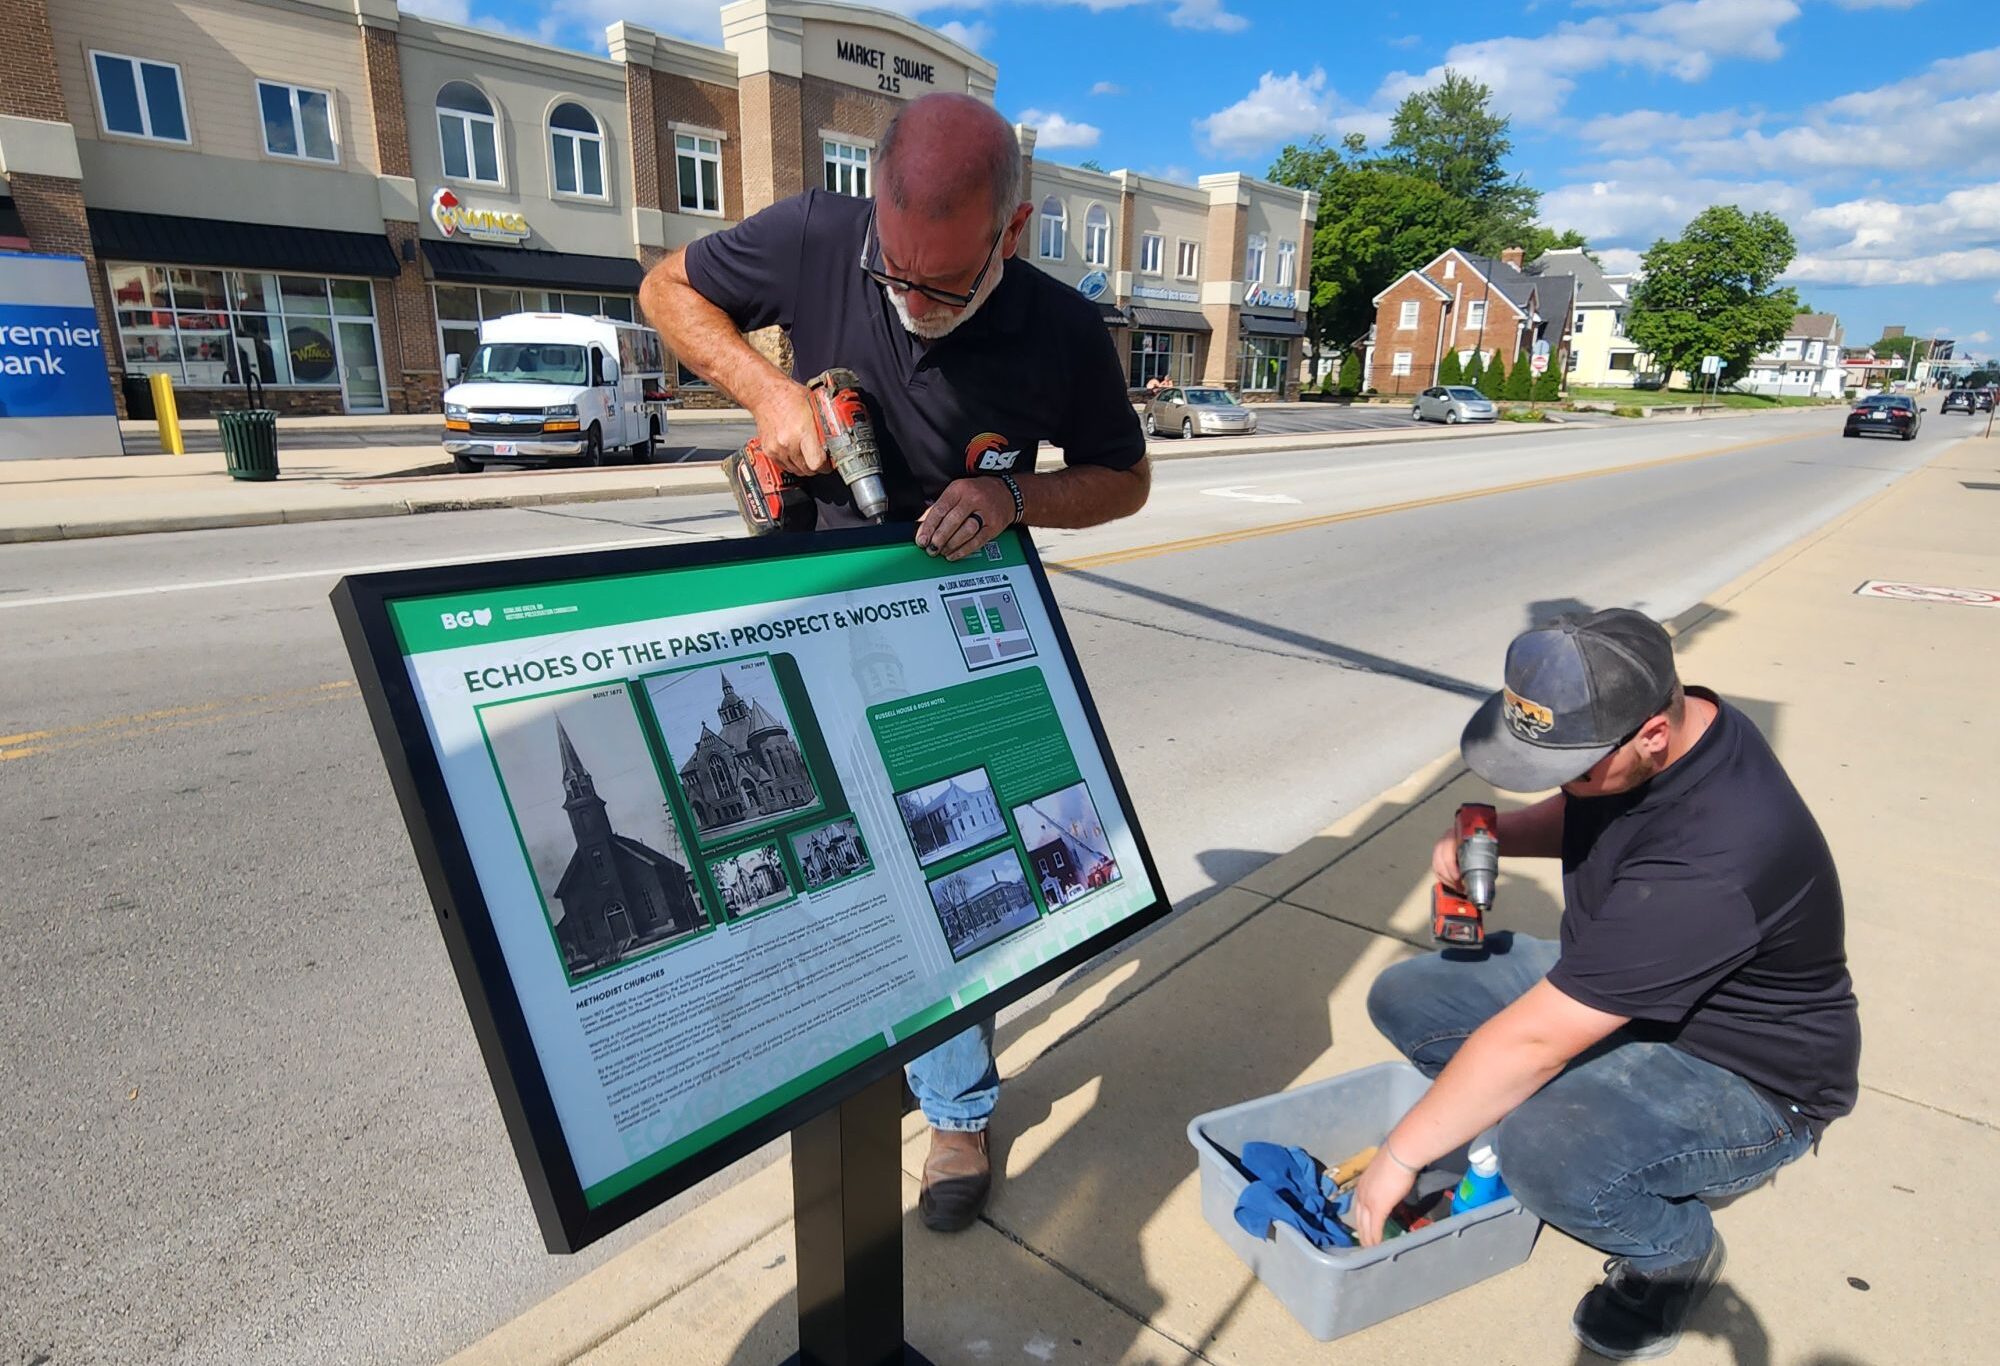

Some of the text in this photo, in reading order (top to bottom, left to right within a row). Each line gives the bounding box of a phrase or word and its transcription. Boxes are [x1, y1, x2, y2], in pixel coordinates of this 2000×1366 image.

[837, 39, 935, 84] MARKET SQUARE
[878, 73, 901, 94] 215
[457, 207, 527, 232] WINGS
[0, 349, 65, 375] ank
[957, 578, 976, 588] ACROSS
[975, 576, 986, 585] THE
[984, 574, 1002, 583] STREET
[440, 610, 474, 630] BG
[464, 596, 930, 695] ECHOES OF THE PAST: PROSPECT & WOOSTER
[739, 662, 754, 670] BUILT
[591, 690, 609, 699] BUILT
[895, 705, 913, 715] HOUSE
[929, 696, 946, 706] HOTEL
[574, 967, 665, 1010] METHODIST CHURCHES
